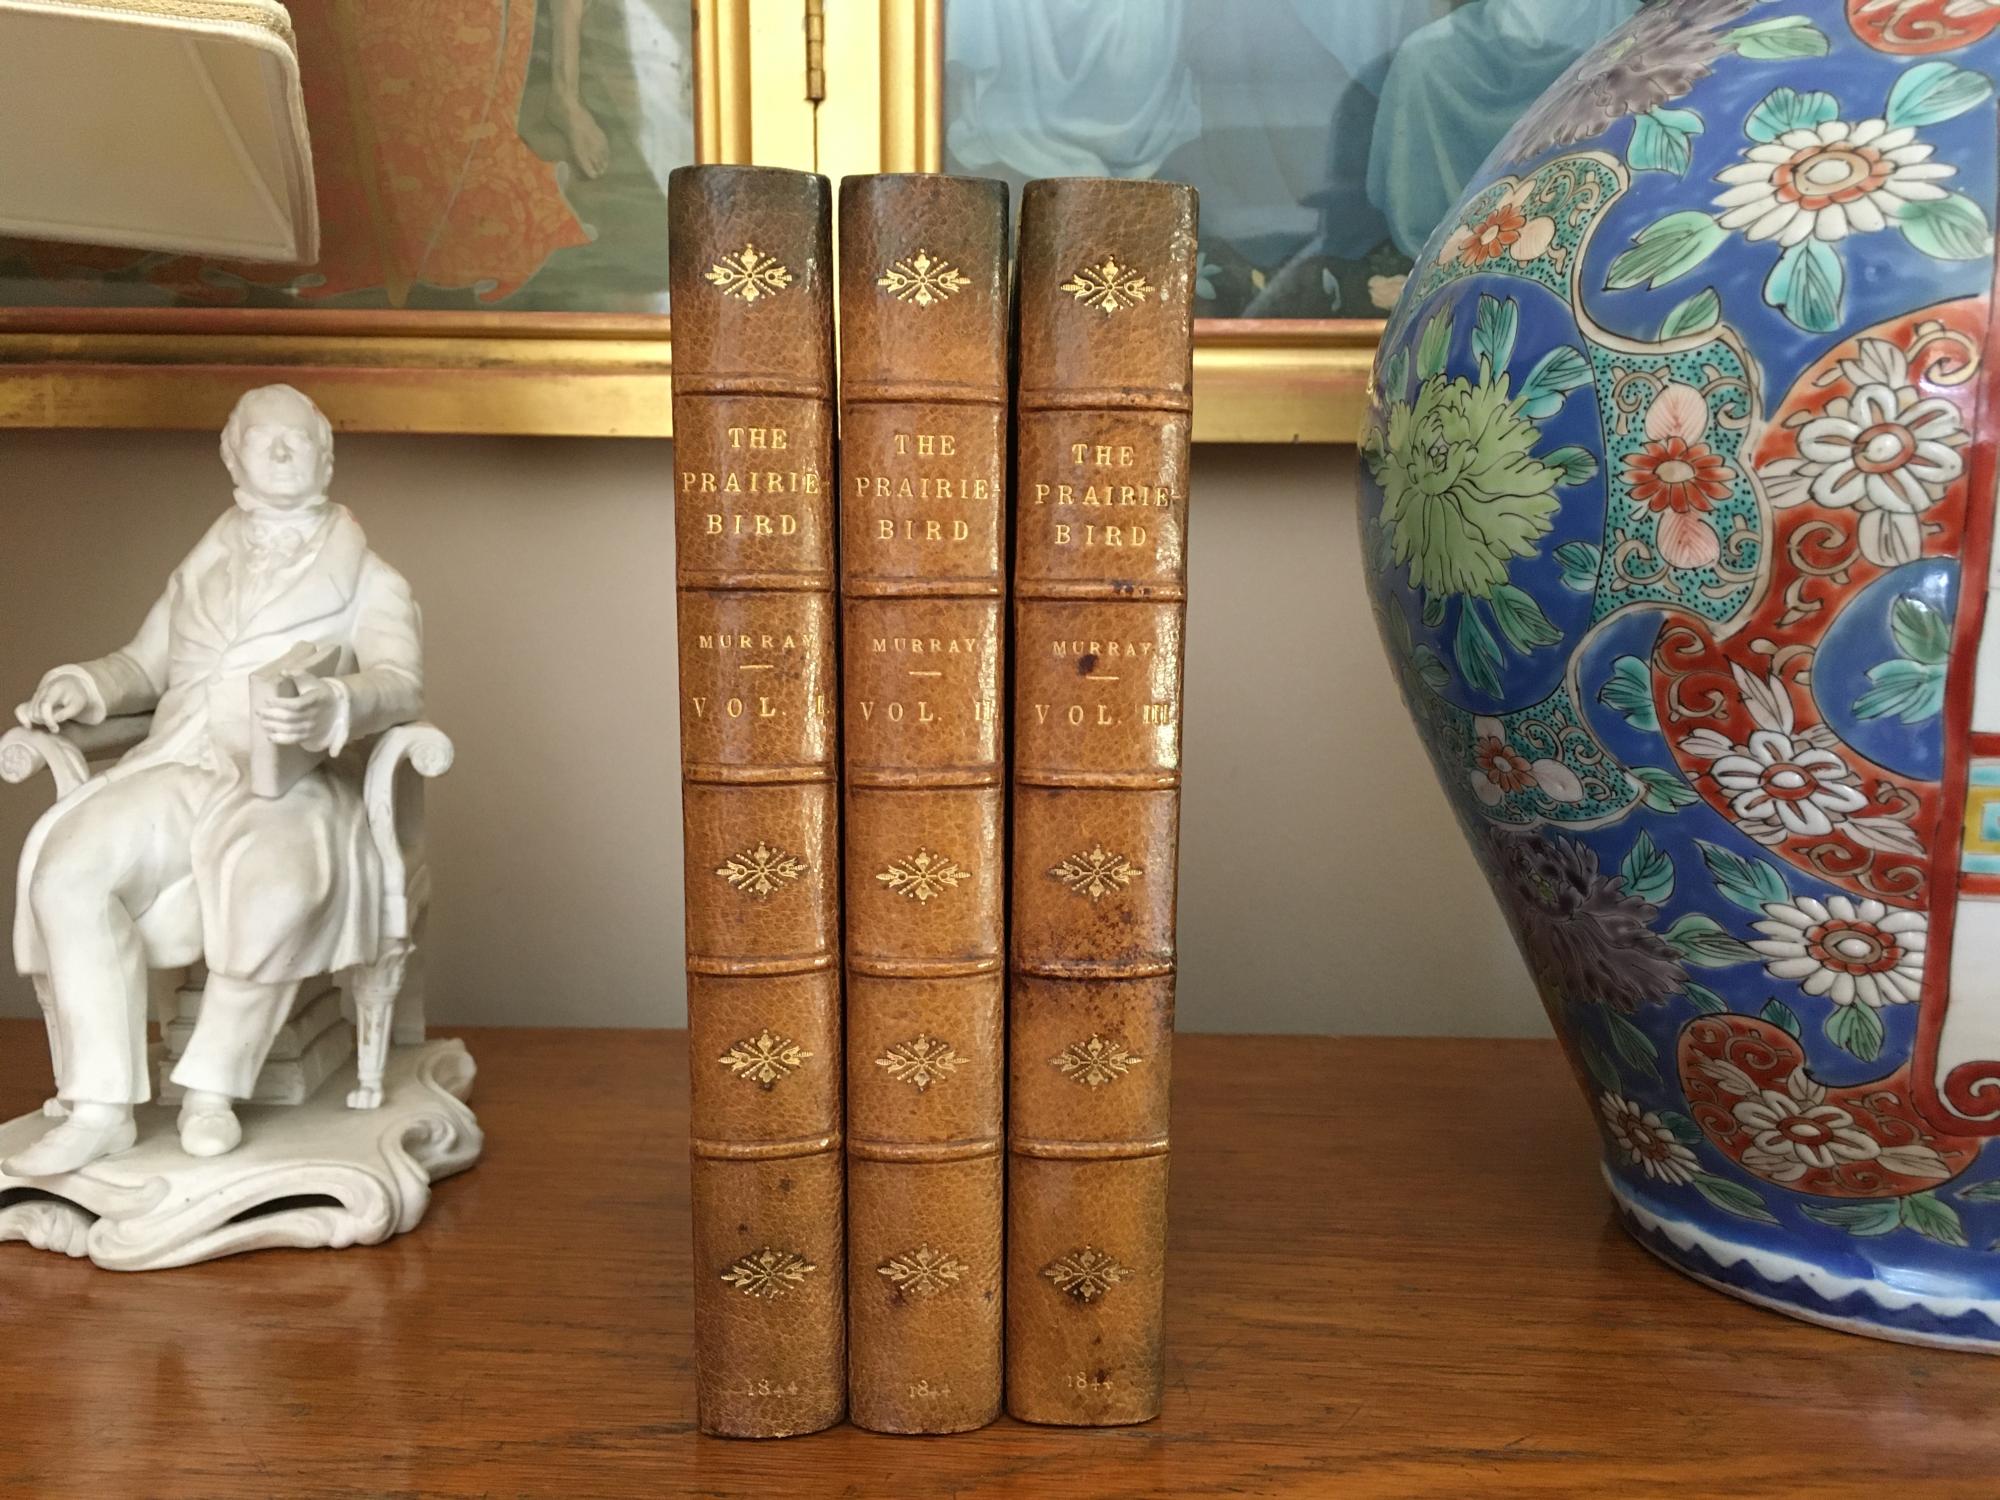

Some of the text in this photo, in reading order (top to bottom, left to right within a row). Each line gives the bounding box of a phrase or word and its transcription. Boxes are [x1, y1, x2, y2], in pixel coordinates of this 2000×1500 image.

[728, 427, 788, 450] THE
[894, 434, 956, 457] THE
[1071, 443, 1135, 467] THE
[706, 513, 797, 536] BIRD
[877, 519, 969, 541] BIRD
[1054, 524, 1147, 547] BIRD
[699, 634, 815, 650] MURRAY
[872, 638, 976, 654] MURRAY
[1052, 640, 1153, 658] MURRAY
[692, 696, 788, 718] VOL.
[859, 701, 943, 722] VOL.
[1035, 703, 1123, 726] VOL.
